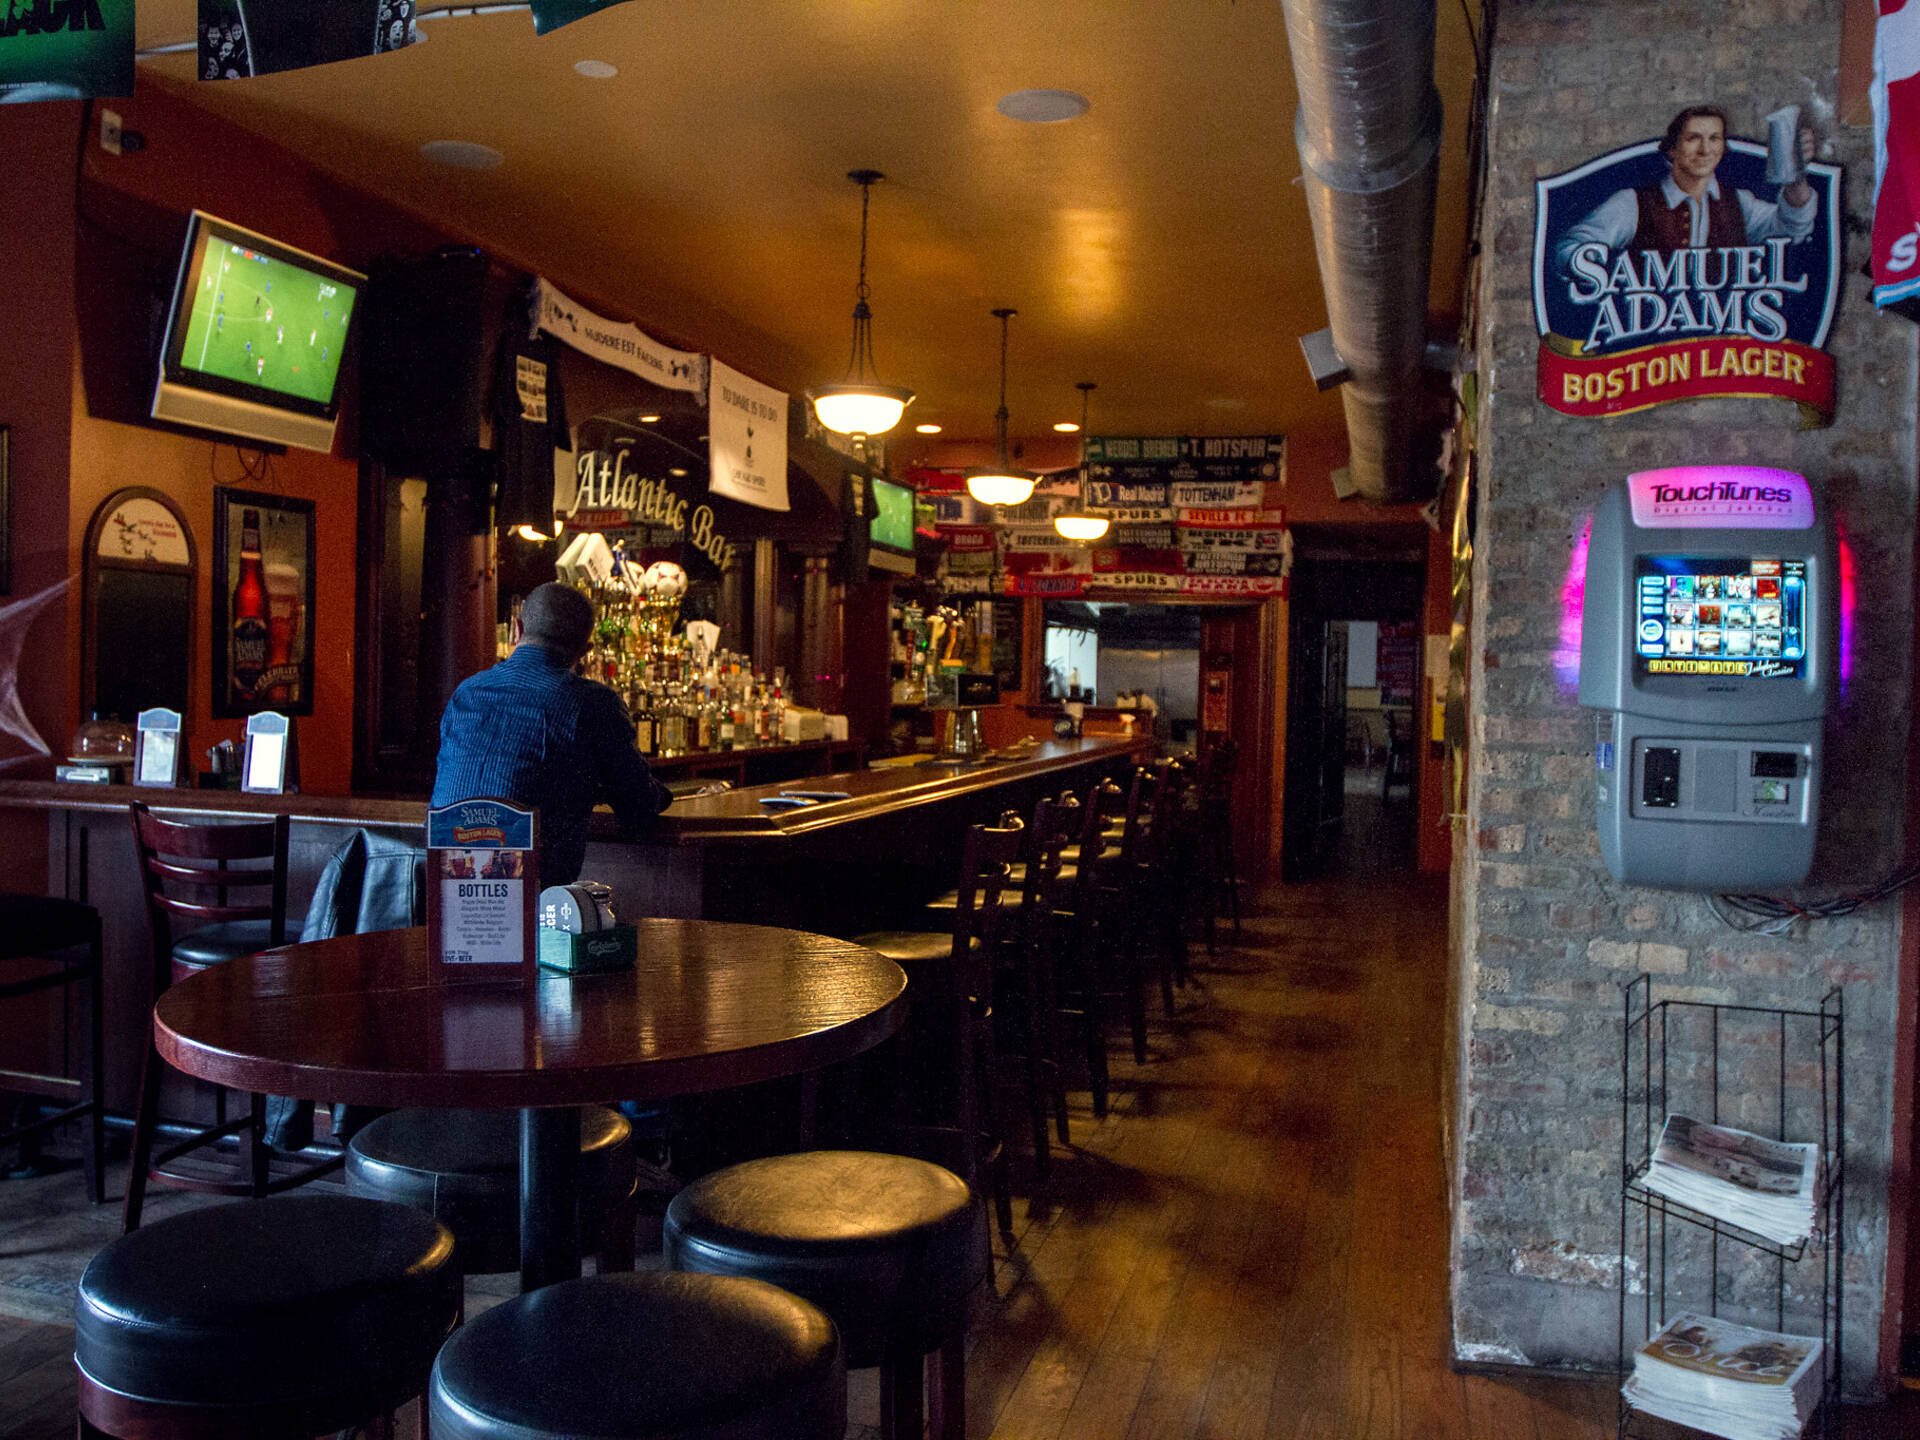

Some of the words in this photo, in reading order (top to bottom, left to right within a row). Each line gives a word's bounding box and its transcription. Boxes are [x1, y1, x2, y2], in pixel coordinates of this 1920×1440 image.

[1569, 237, 1809, 305] SAMUEL
[1580, 289, 1788, 352] ADAMS
[1563, 350, 1691, 403] BOSTON
[1700, 346, 1807, 386] LAGER
[1204, 439, 1267, 458] HOTSPUR
[1180, 486, 1236, 502] TOTTENHAM
[1650, 482, 1793, 503] TouchTunes
[566, 449, 688, 531] Atlantic
[691, 504, 737, 571] Bar
[1108, 509, 1162, 519] SPURS
[1113, 574, 1168, 585] SPURS
[1649, 660, 1747, 674] ULTIMATE
[460, 806, 501, 818] SAMUEL
[463, 816, 498, 826] ADAMS
[458, 884, 509, 898] BOTTLES
